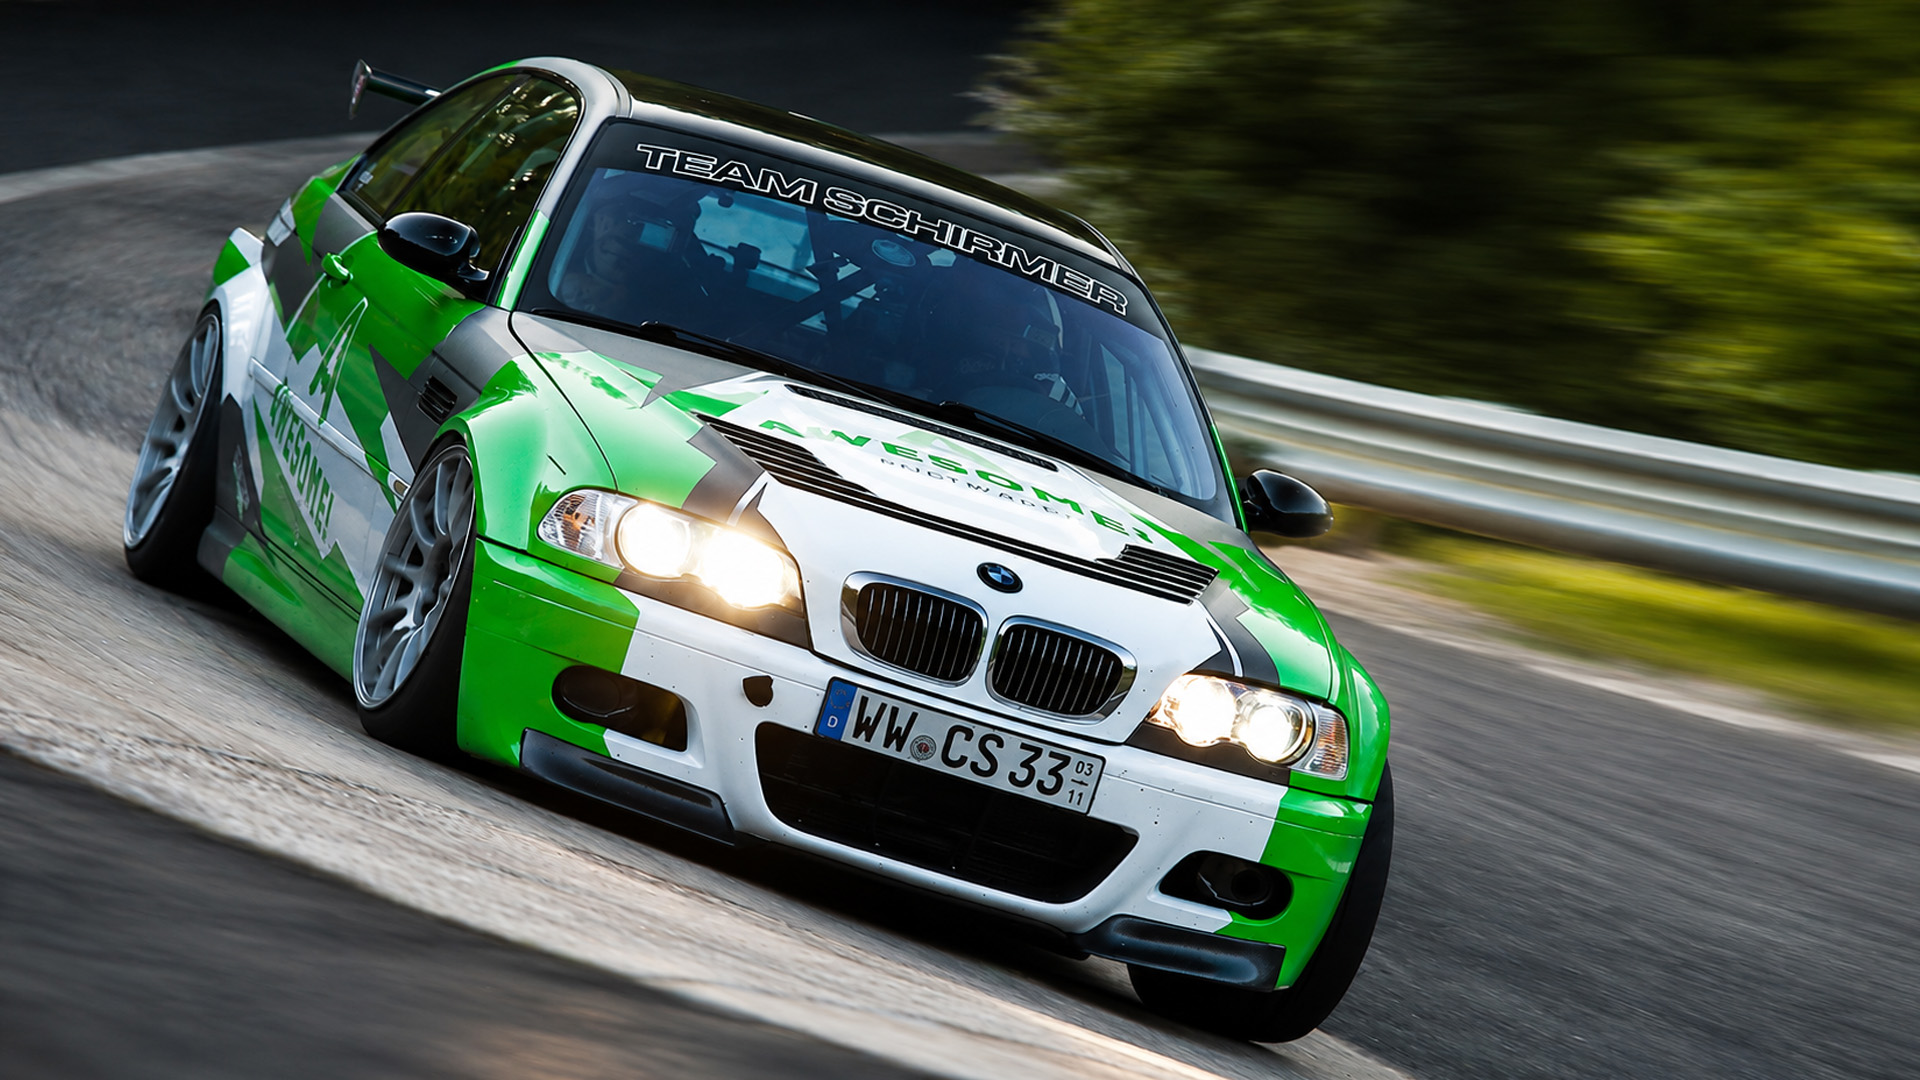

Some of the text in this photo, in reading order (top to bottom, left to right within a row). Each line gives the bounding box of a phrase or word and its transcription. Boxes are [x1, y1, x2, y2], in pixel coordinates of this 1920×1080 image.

[636, 143, 1129, 317] TEAM SCHIRMER
[827, 715, 838, 728] D
[852, 696, 918, 753] WW
[941, 724, 1004, 778] CS
[1008, 742, 1071, 796] 33
[1075, 760, 1093, 776] 03
[1068, 789, 1084, 806] 11
